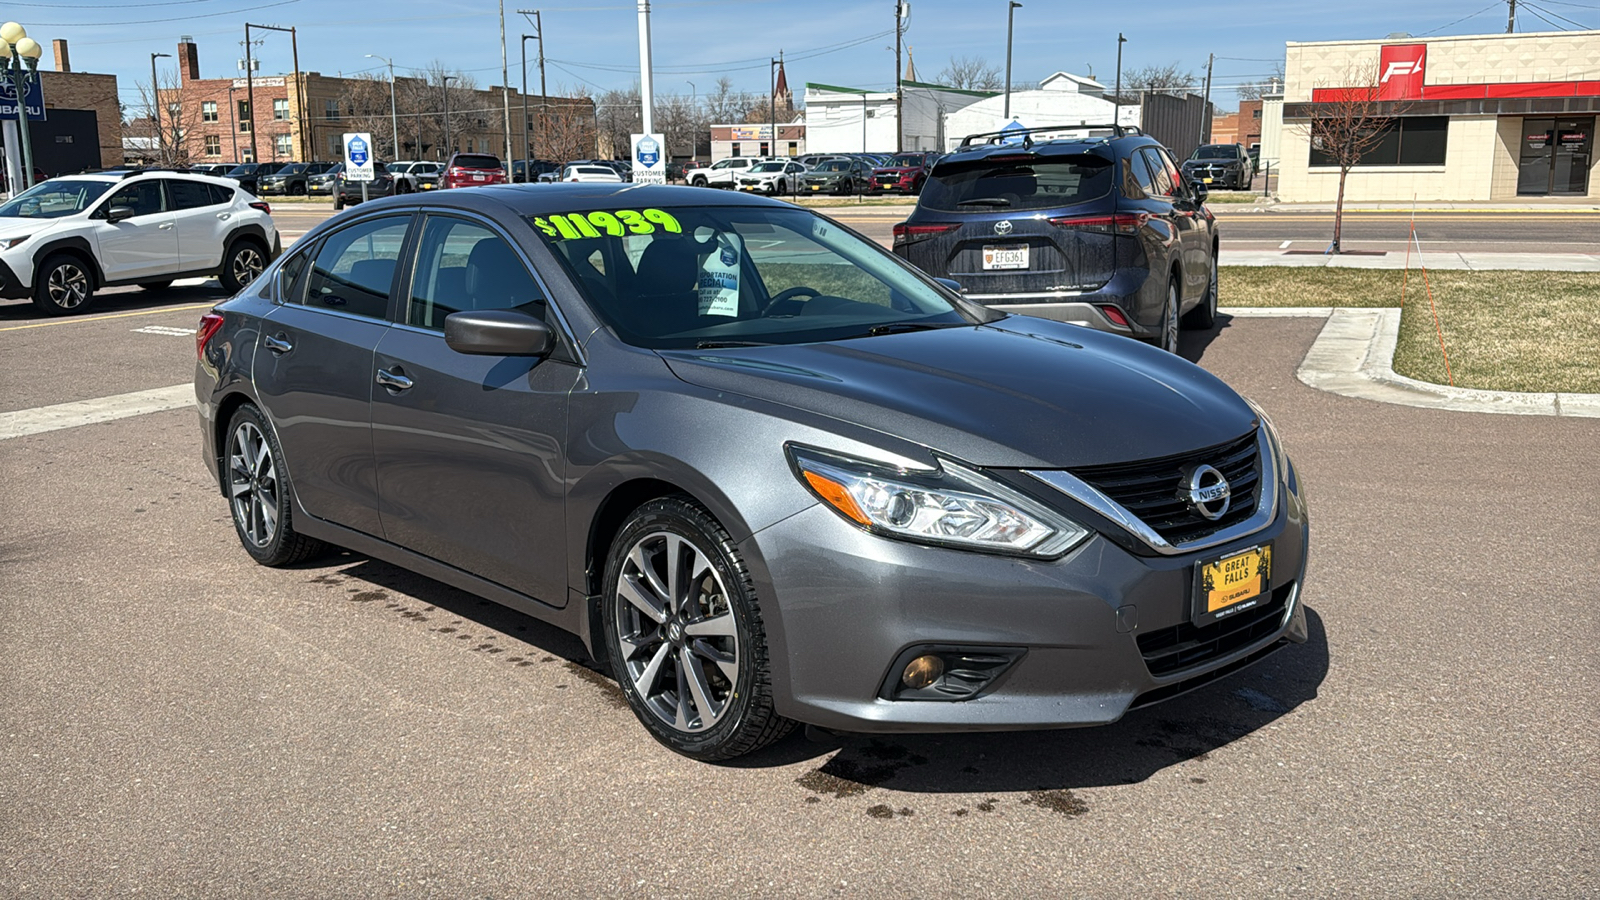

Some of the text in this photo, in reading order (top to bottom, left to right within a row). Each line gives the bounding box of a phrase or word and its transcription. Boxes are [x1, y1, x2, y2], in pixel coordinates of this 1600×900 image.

[534, 208, 682, 239] $11939
[995, 251, 1024, 263] EFG361
[1225, 557, 1250, 572] GREAT
[1224, 568, 1249, 585] FALLS
[1229, 588, 1250, 600] SUBARU
